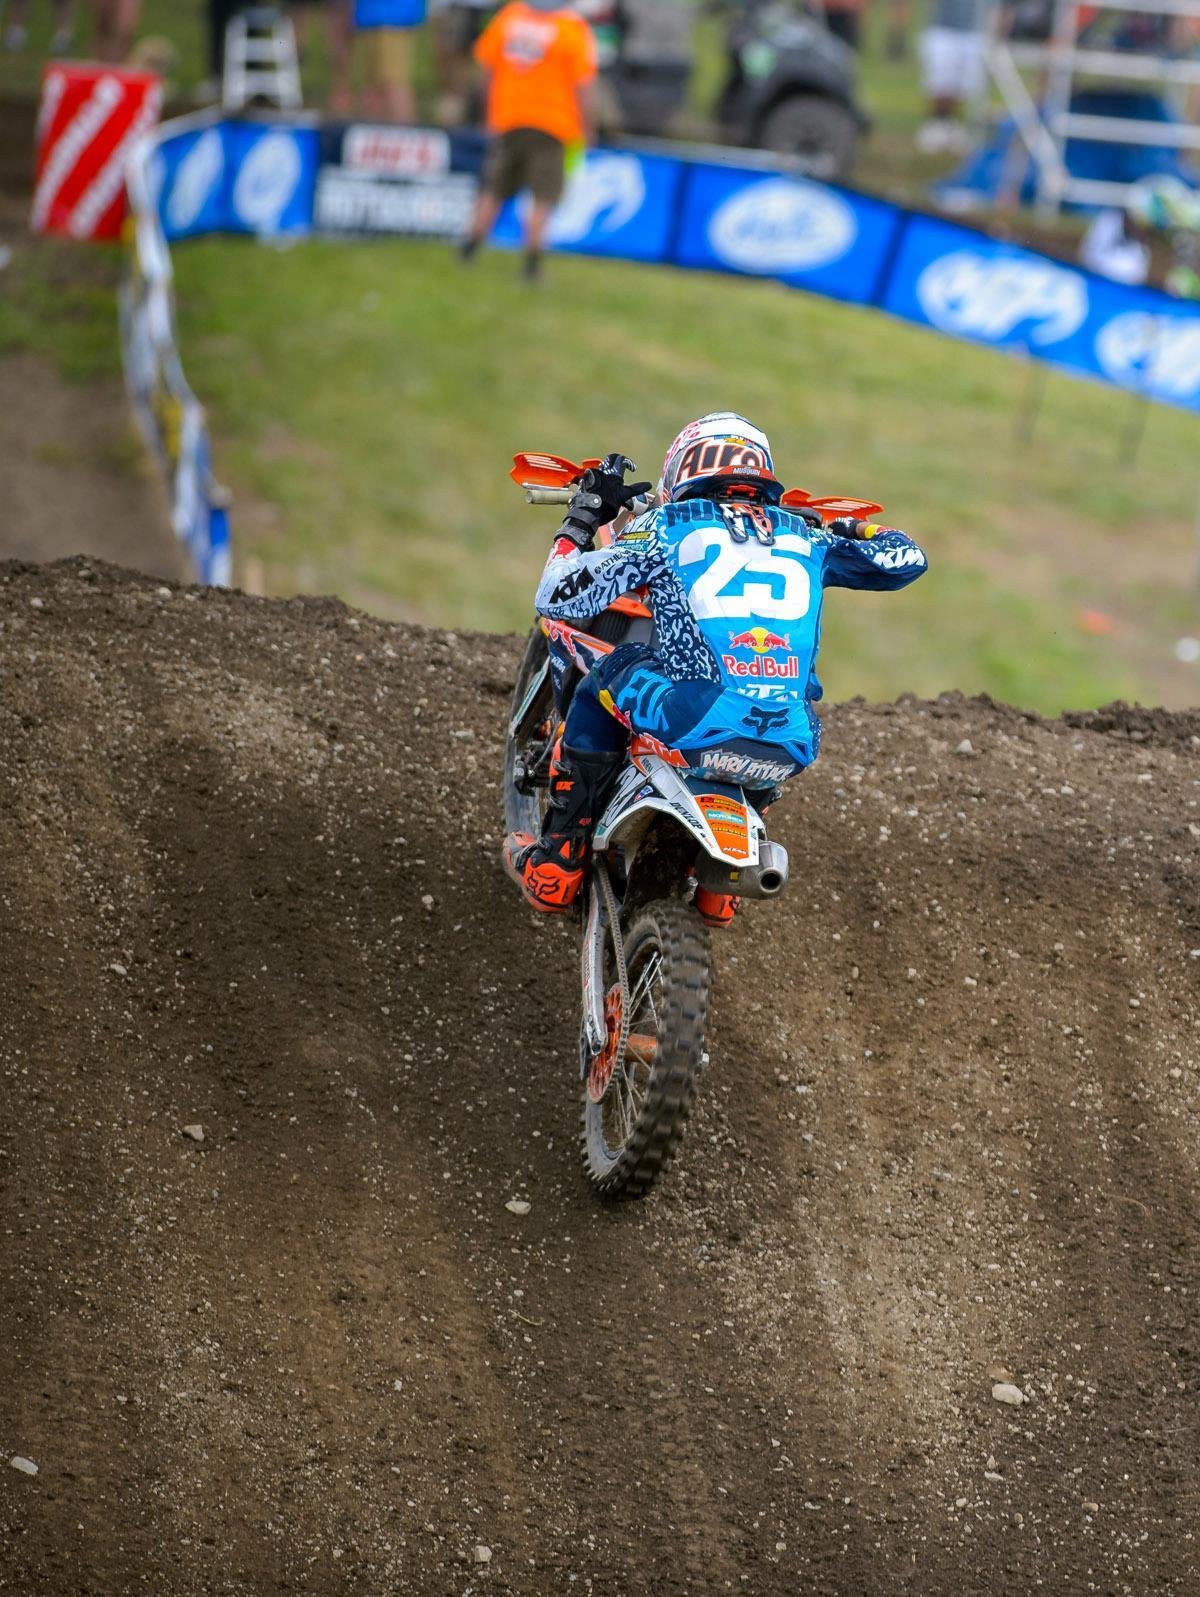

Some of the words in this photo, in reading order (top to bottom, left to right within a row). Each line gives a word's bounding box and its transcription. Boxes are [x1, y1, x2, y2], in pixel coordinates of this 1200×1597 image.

[873, 544, 926, 569] KTM
[548, 565, 596, 605] KTM
[678, 526, 811, 621] 25
[722, 654, 761, 677] Red
[762, 655, 799, 678] Bull
[742, 761, 795, 782] ATTACK
